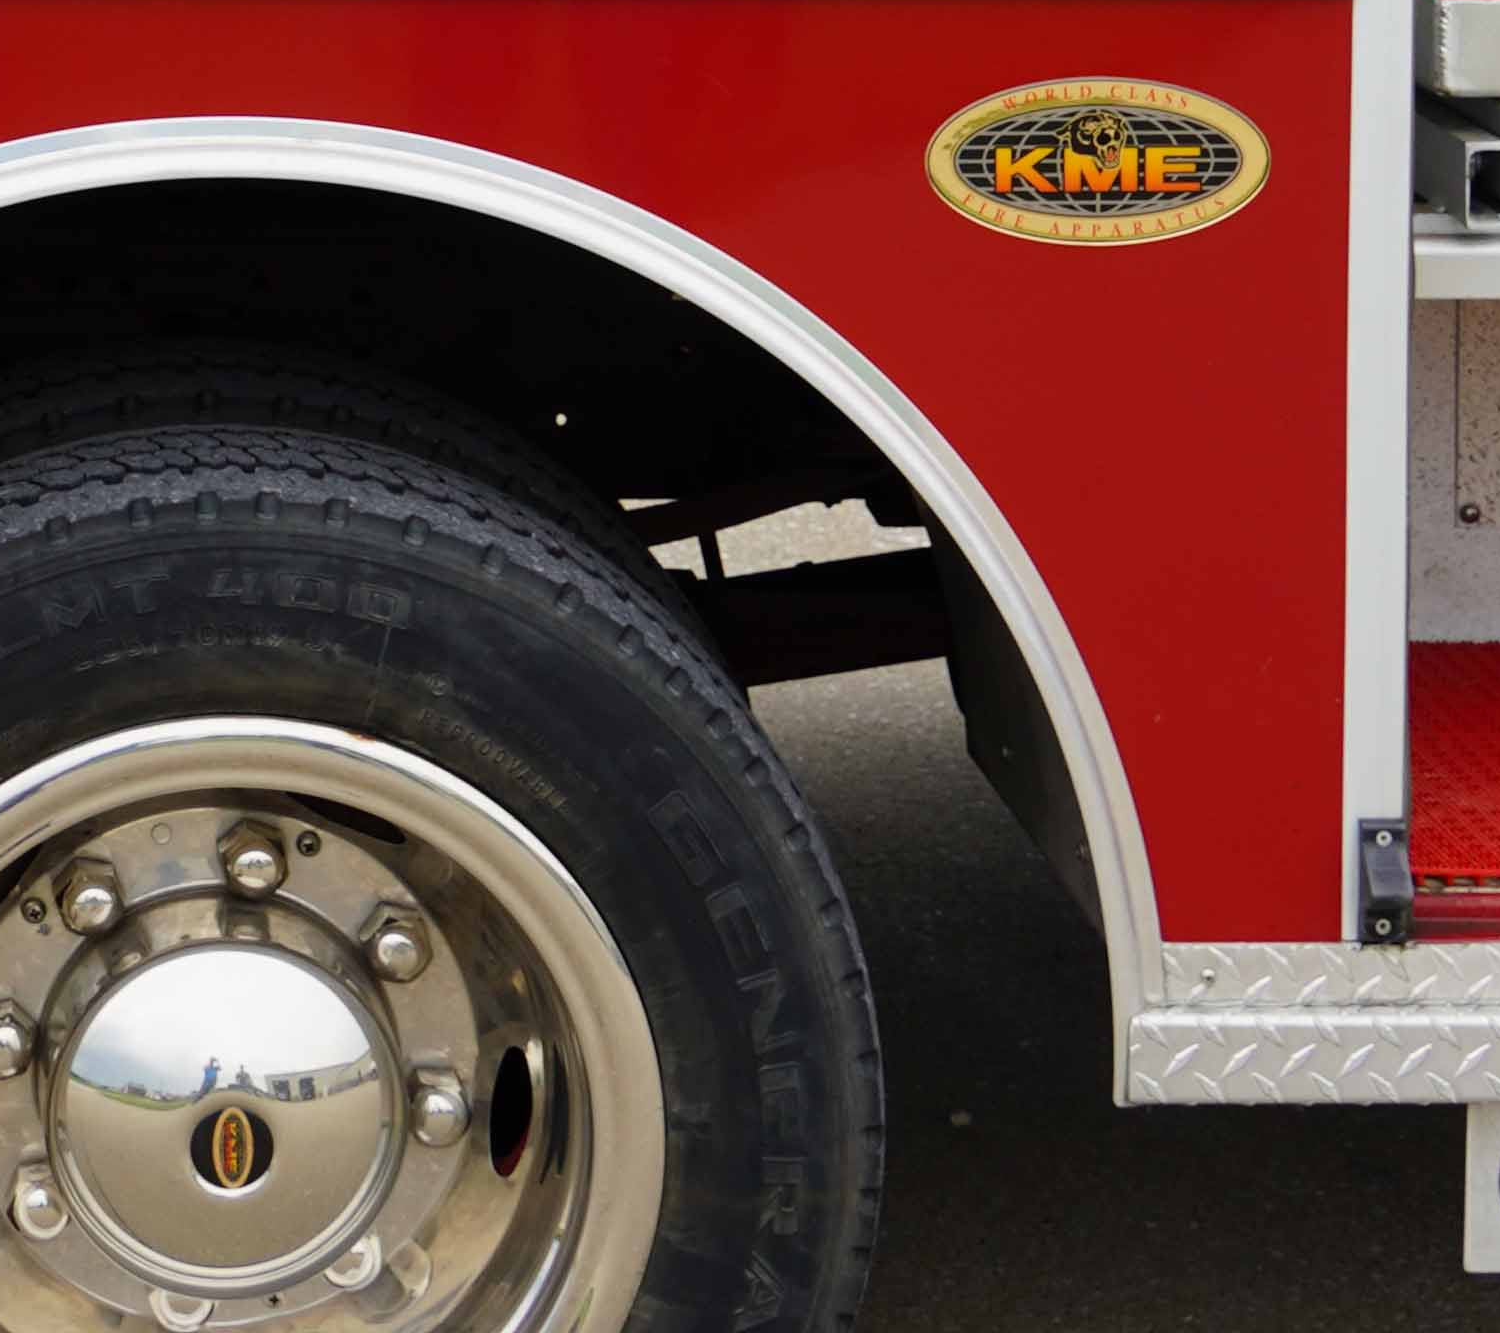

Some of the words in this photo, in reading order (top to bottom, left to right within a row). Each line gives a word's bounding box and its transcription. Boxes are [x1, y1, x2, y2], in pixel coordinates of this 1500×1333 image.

[1002, 84, 1092, 111] WORLD
[1110, 84, 1190, 110] CLASS
[994, 146, 1202, 194] KME
[961, 193, 1026, 230] FIRE
[1048, 197, 1228, 238] APPARATUS
[205, 567, 414, 630] 400
